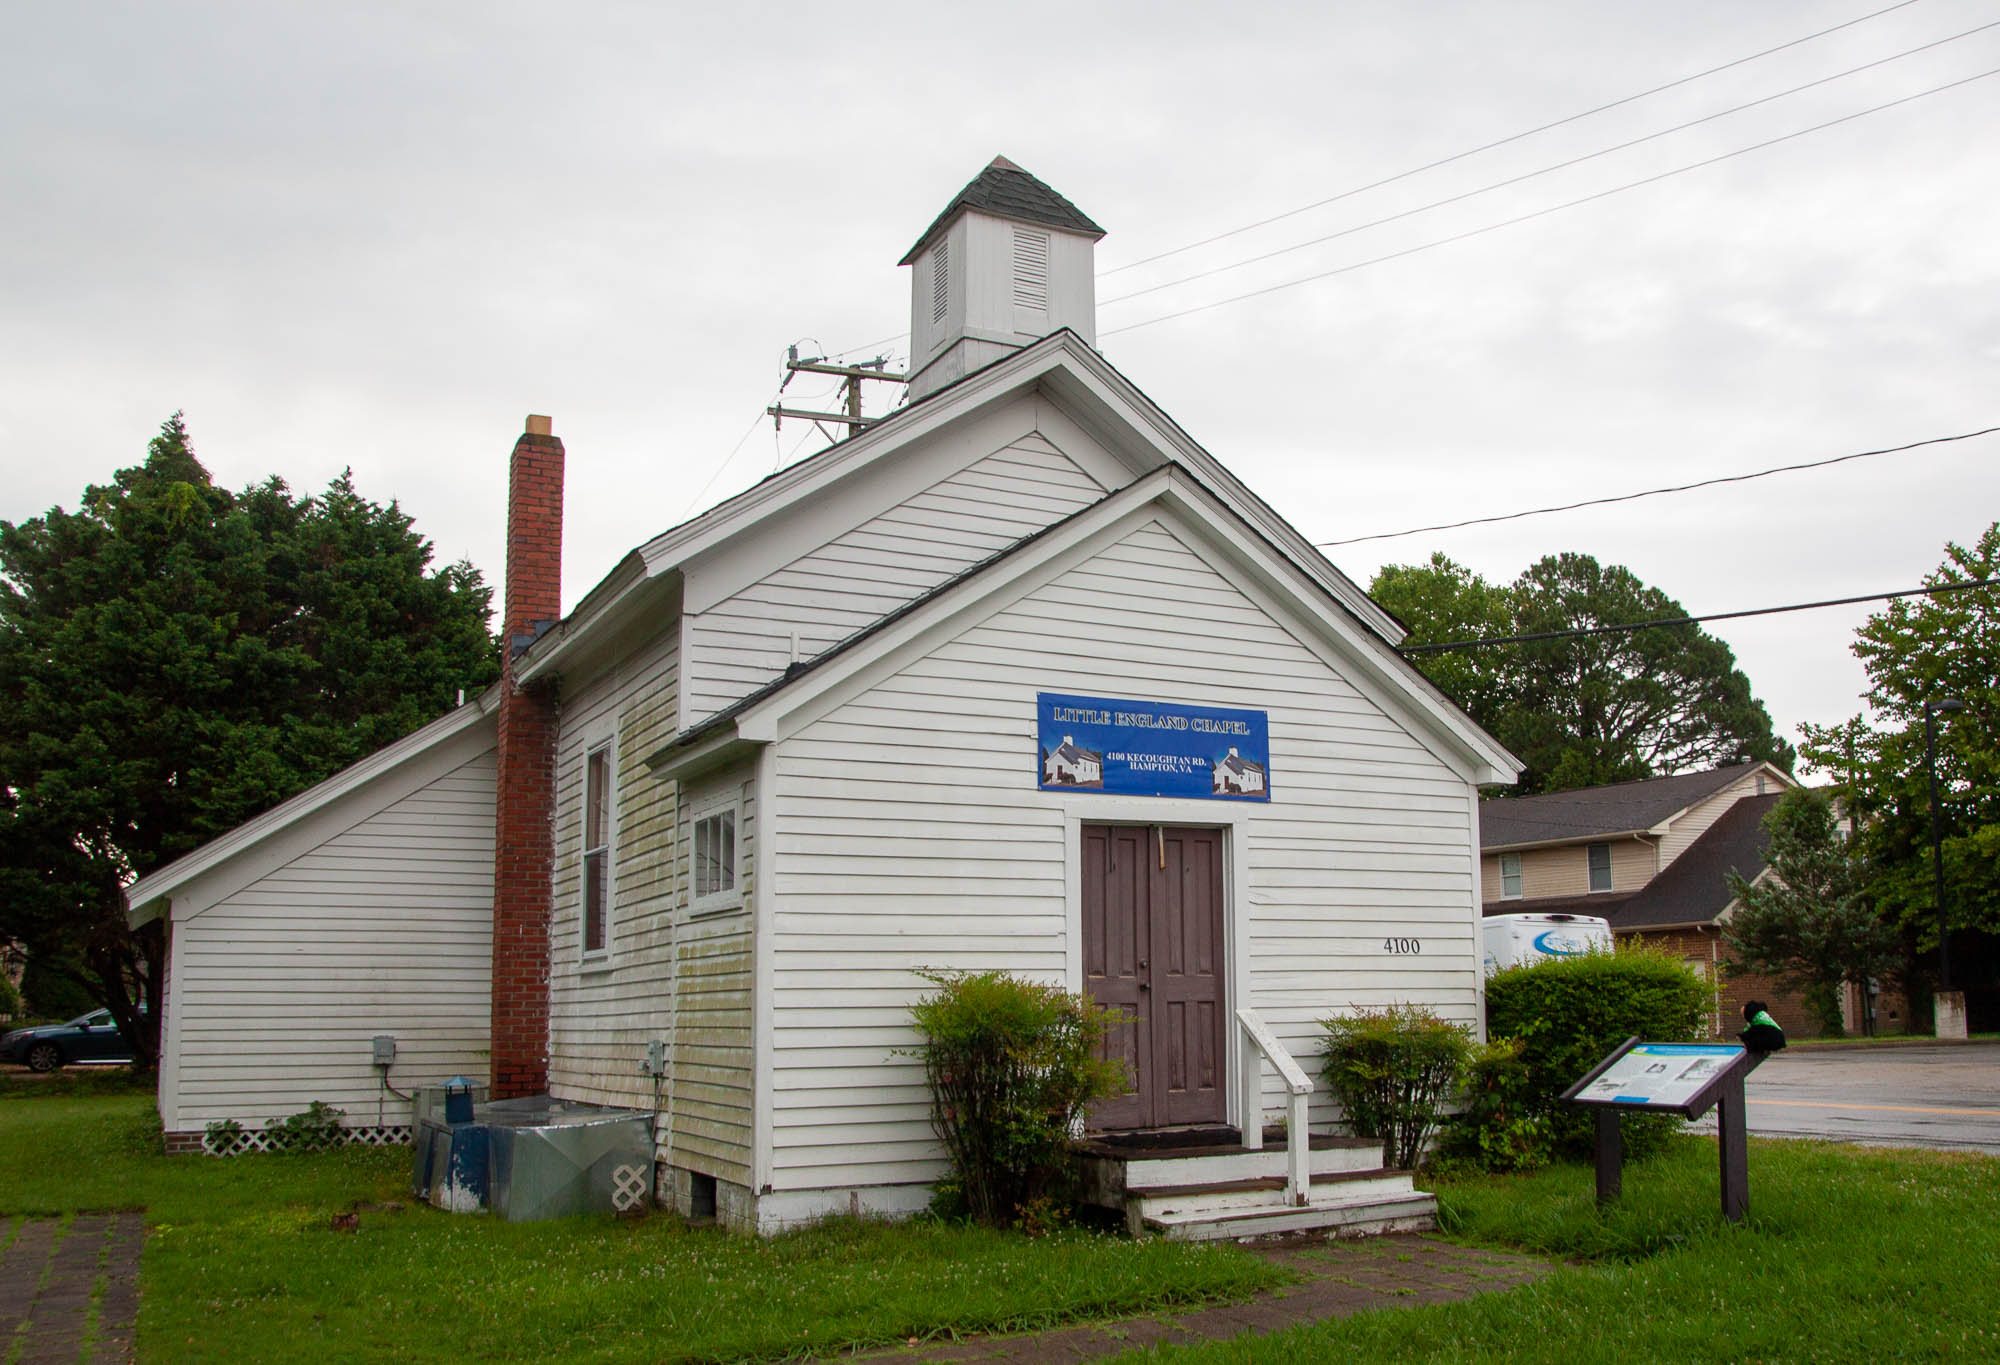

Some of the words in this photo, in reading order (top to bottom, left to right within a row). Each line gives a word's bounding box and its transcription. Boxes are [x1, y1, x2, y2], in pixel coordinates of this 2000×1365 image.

[1053, 707, 1111, 724] LITTLE
[1115, 712, 1188, 730] ENGLAND
[1191, 718, 1250, 735] CHAPEL
[1106, 752, 1125, 762] 4100
[1127, 753, 1191, 765] KECOUGHTAN
[1192, 757, 1207, 767] RD.
[1130, 762, 1178, 773] HAMPTON,
[1179, 765, 1192, 774] VA
[1384, 938, 1420, 954] 4100
